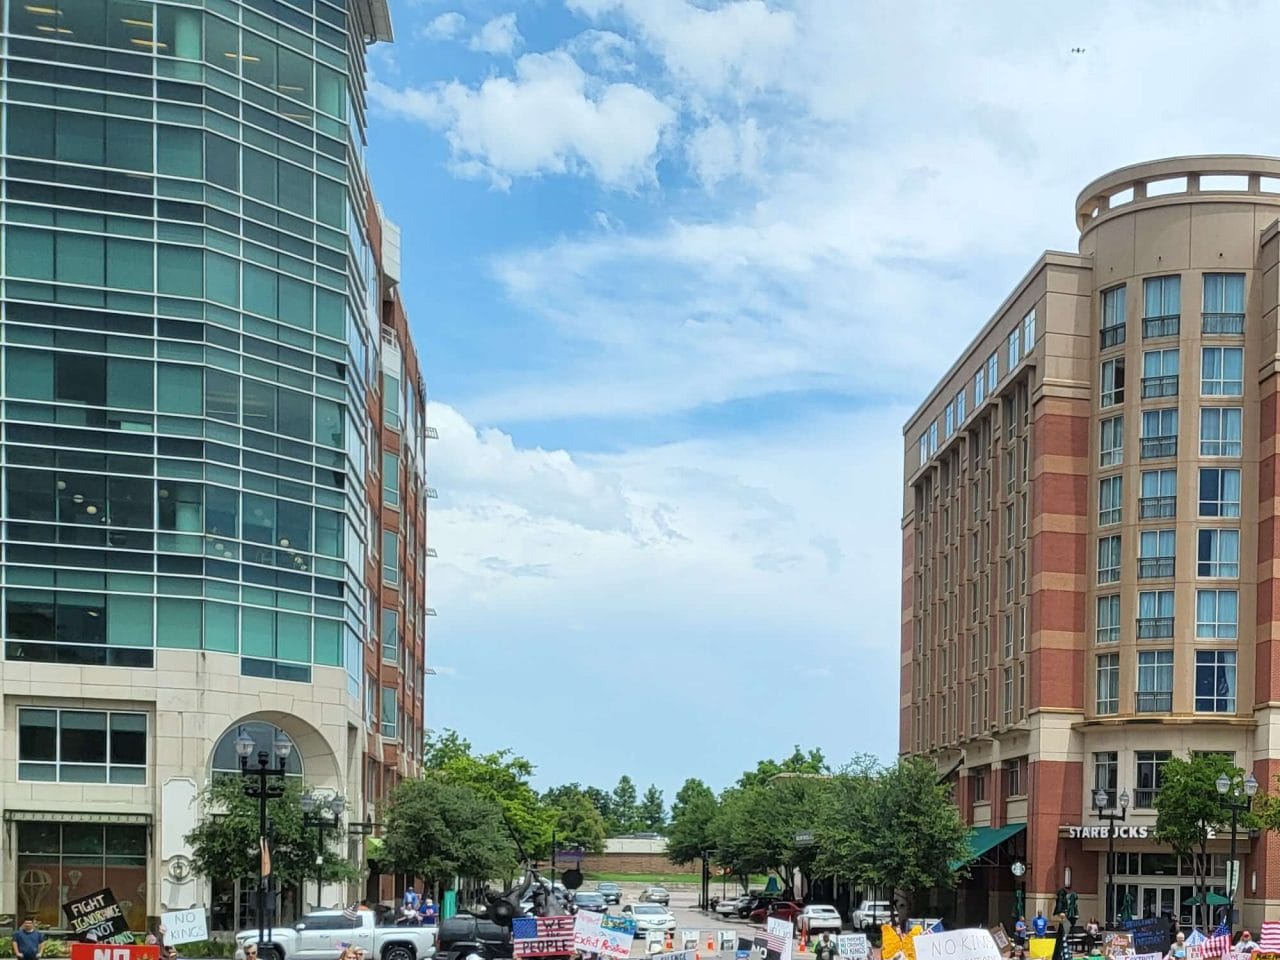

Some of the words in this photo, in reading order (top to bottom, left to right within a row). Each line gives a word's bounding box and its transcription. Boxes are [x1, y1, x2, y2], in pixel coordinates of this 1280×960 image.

[71, 894, 105, 917] FIGHT
[71, 903, 122, 931] IGNORANCE
[175, 912, 196, 924] NO
[543, 919, 567, 928] WE
[95, 921, 114, 937] NOT
[170, 926, 206, 940] KINGS
[522, 940, 568, 953] PEOPLE
[931, 938, 957, 957] NO
